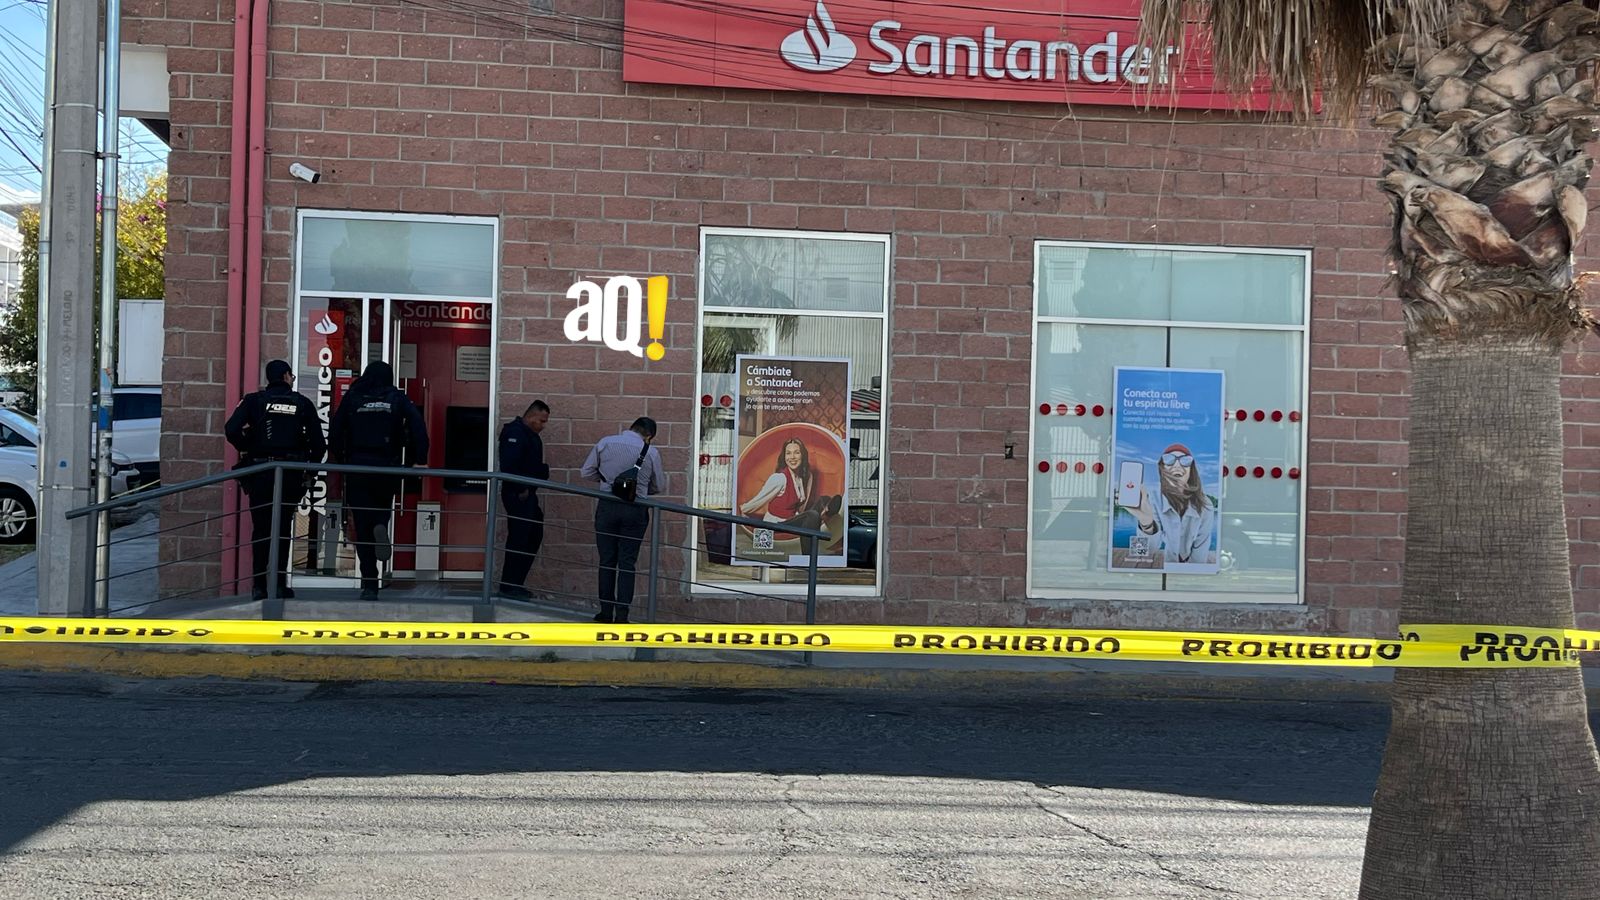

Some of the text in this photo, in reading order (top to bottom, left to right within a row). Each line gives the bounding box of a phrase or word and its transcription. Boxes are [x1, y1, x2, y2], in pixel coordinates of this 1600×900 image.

[867, 19, 1180, 85] Santander
[746, 365, 792, 376] Cámbiate
[754, 377, 803, 388] Santander
[1123, 388, 1178, 399] Conecta con
[1123, 398, 1133, 407] tu
[1170, 399, 1190, 410] libre
[595, 632, 832, 647] PROHIBIDO
[893, 634, 1121, 654] PROHIBIDO
[1181, 639, 1402, 660] PROHIBIDO
